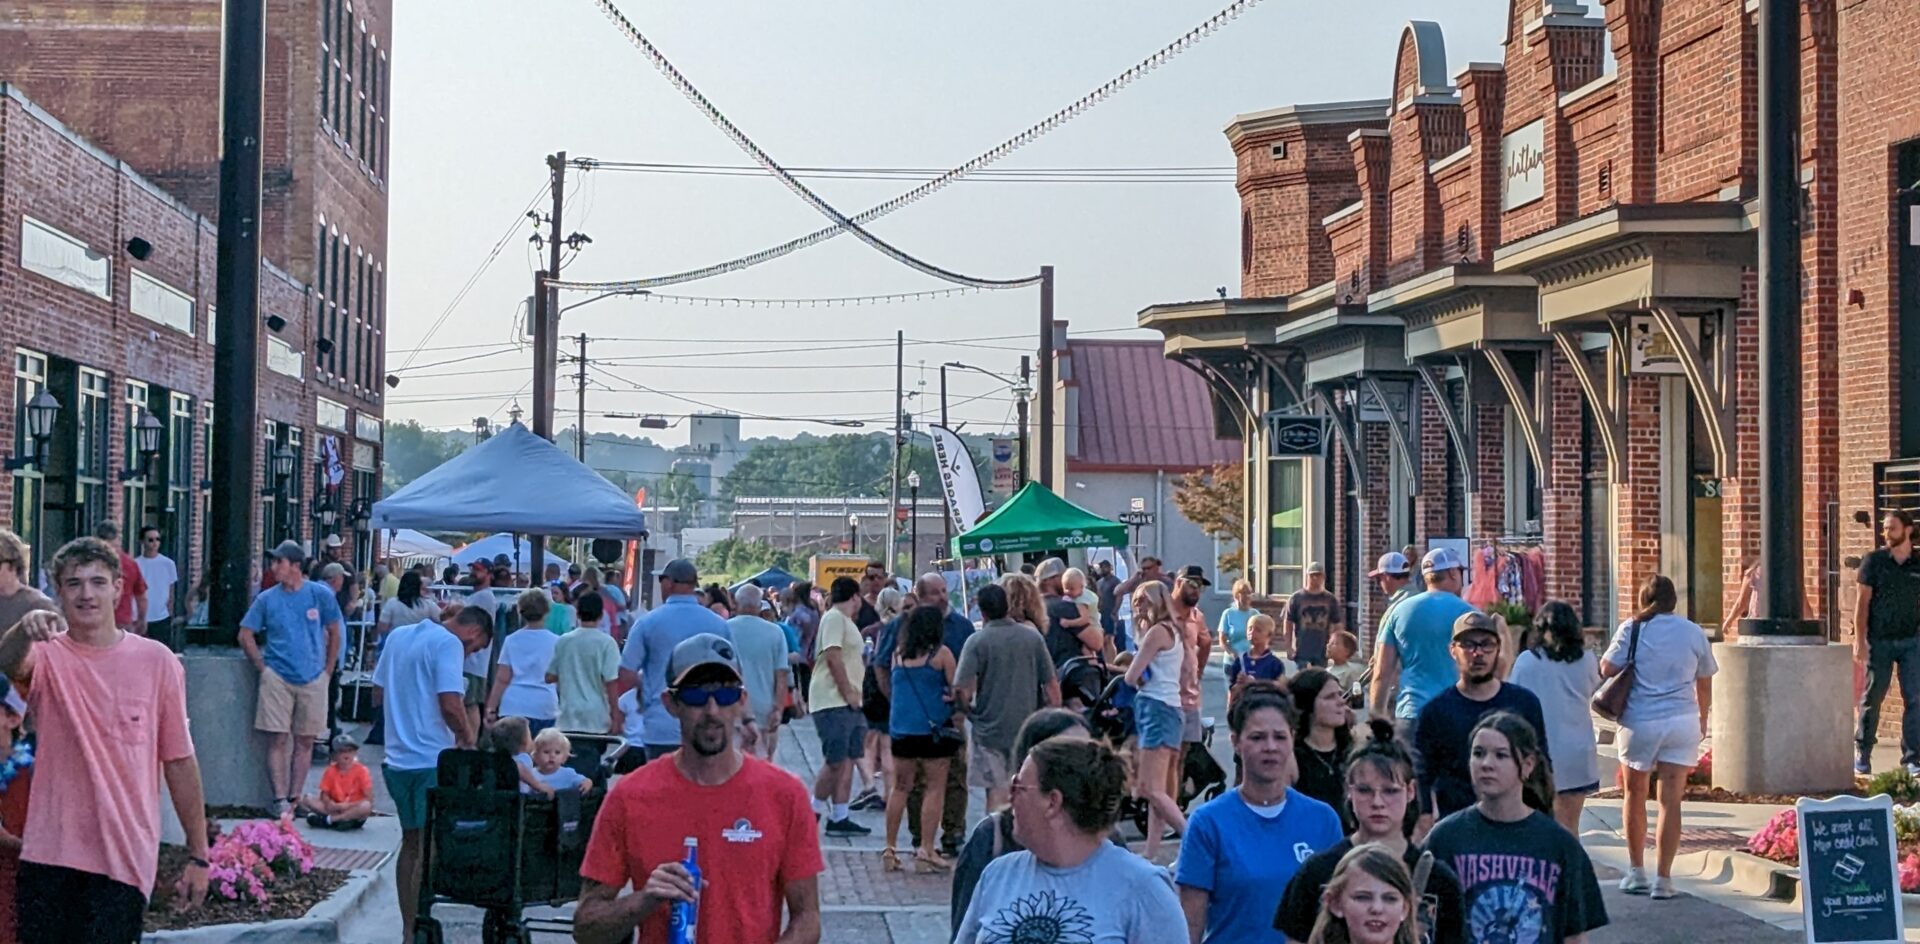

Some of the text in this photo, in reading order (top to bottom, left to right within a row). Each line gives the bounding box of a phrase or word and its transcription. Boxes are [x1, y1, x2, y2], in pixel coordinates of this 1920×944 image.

[1056, 534, 1092, 547] sprout
[1812, 820, 1829, 837] We
[1454, 853, 1562, 906] NASHVILLE
